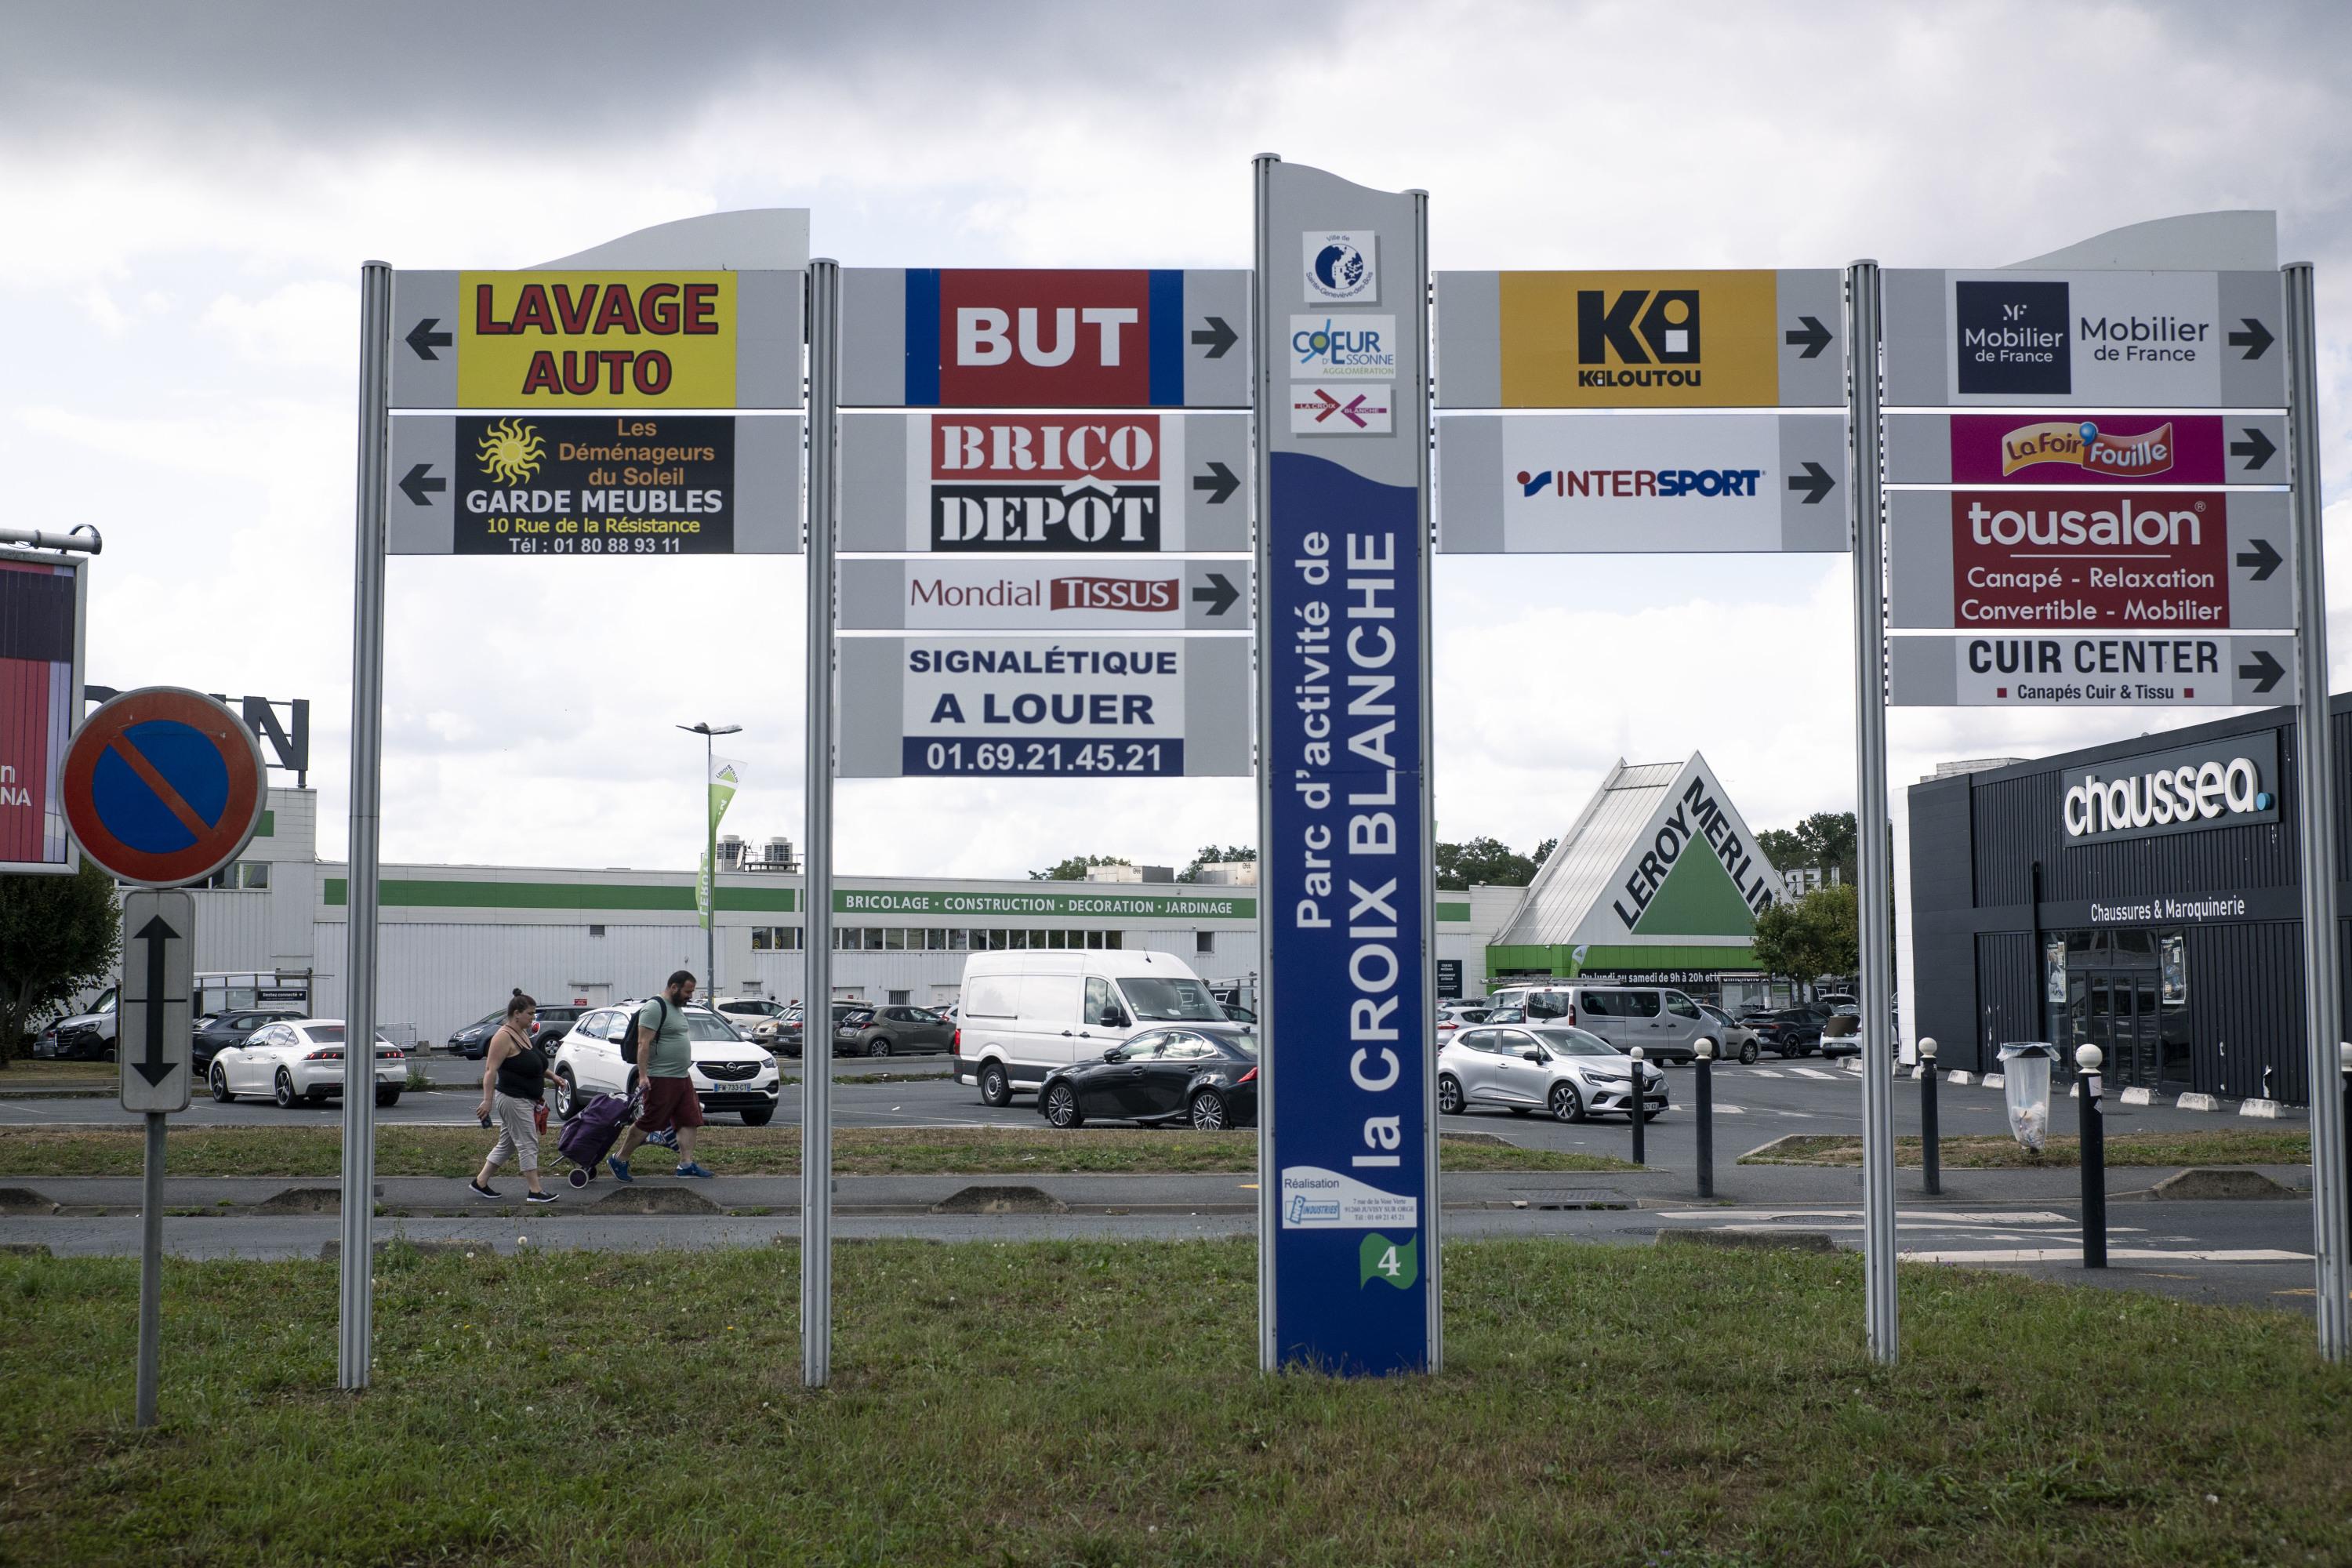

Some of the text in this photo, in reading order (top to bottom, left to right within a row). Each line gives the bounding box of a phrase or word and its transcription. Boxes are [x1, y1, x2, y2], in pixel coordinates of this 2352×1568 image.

[476, 283, 719, 336] LAVAGE
[957, 307, 1138, 367] BUT
[1965, 328, 2063, 347] Mobilier
[2081, 317, 2209, 342] Mobilier
[1975, 350, 2053, 362] de France
[2094, 345, 2196, 361] de France
[521, 350, 672, 395] AUTO
[1323, 366, 1394, 376] AGGLOMÉRATION
[618, 419, 657, 437] Les
[559, 442, 715, 464] Déménageurs
[941, 426, 1152, 470] BRICO
[2006, 441, 2037, 460] La
[2090, 441, 2167, 466] Fouille
[589, 467, 684, 486] du Soleil
[1558, 470, 1761, 496] INTERSPORT
[466, 490, 723, 514] GARDE MEUBLES
[488, 517, 700, 533] 10 Rue de la Résistance
[509, 537, 536, 553] Tél
[554, 537, 574, 553] 01
[581, 537, 602, 553] 80
[608, 537, 629, 553] 88
[634, 537, 656, 553] 93
[662, 537, 681, 553] 11
[1968, 567, 2062, 591] Canapé
[2090, 568, 2215, 588] Relaxation
[911, 579, 1170, 607] Mondial TISSUS
[1962, 599, 2096, 620] Convertible
[2124, 600, 2223, 620] Mobilier
[909, 646, 1177, 676] SIGNALÉTIQUE
[1969, 640, 2218, 673] CUIR CENTER
[2017, 684, 2174, 702] Canapés Cuir & Tissu
[931, 694, 1155, 724] A LOUER
[1294, 532, 1331, 927] Parc d'activité de
[927, 743, 1160, 771] 01.69.21.45.21
[1347, 533, 1400, 1167] la CROIX BLANCHE
[1613, 801, 1691, 931] LEROY
[846, 895, 1232, 914] BRICOLAGE CONSTRUCTION DECORATION JARDINAGE
[2091, 895, 2245, 922] Chaussures & Maroquinerie
[1628, 972, 1657, 982] samedi
[1658, 972, 1668, 982] de
[1670, 972, 1680, 982] 9h
[1682, 971, 1686, 982] à
[1688, 973, 1703, 982] 20h
[1284, 1178, 1340, 1189] Réalisation
[1303, 1205, 1338, 1214] INDUSTRIES
[1377, 1246, 1402, 1276] 4
